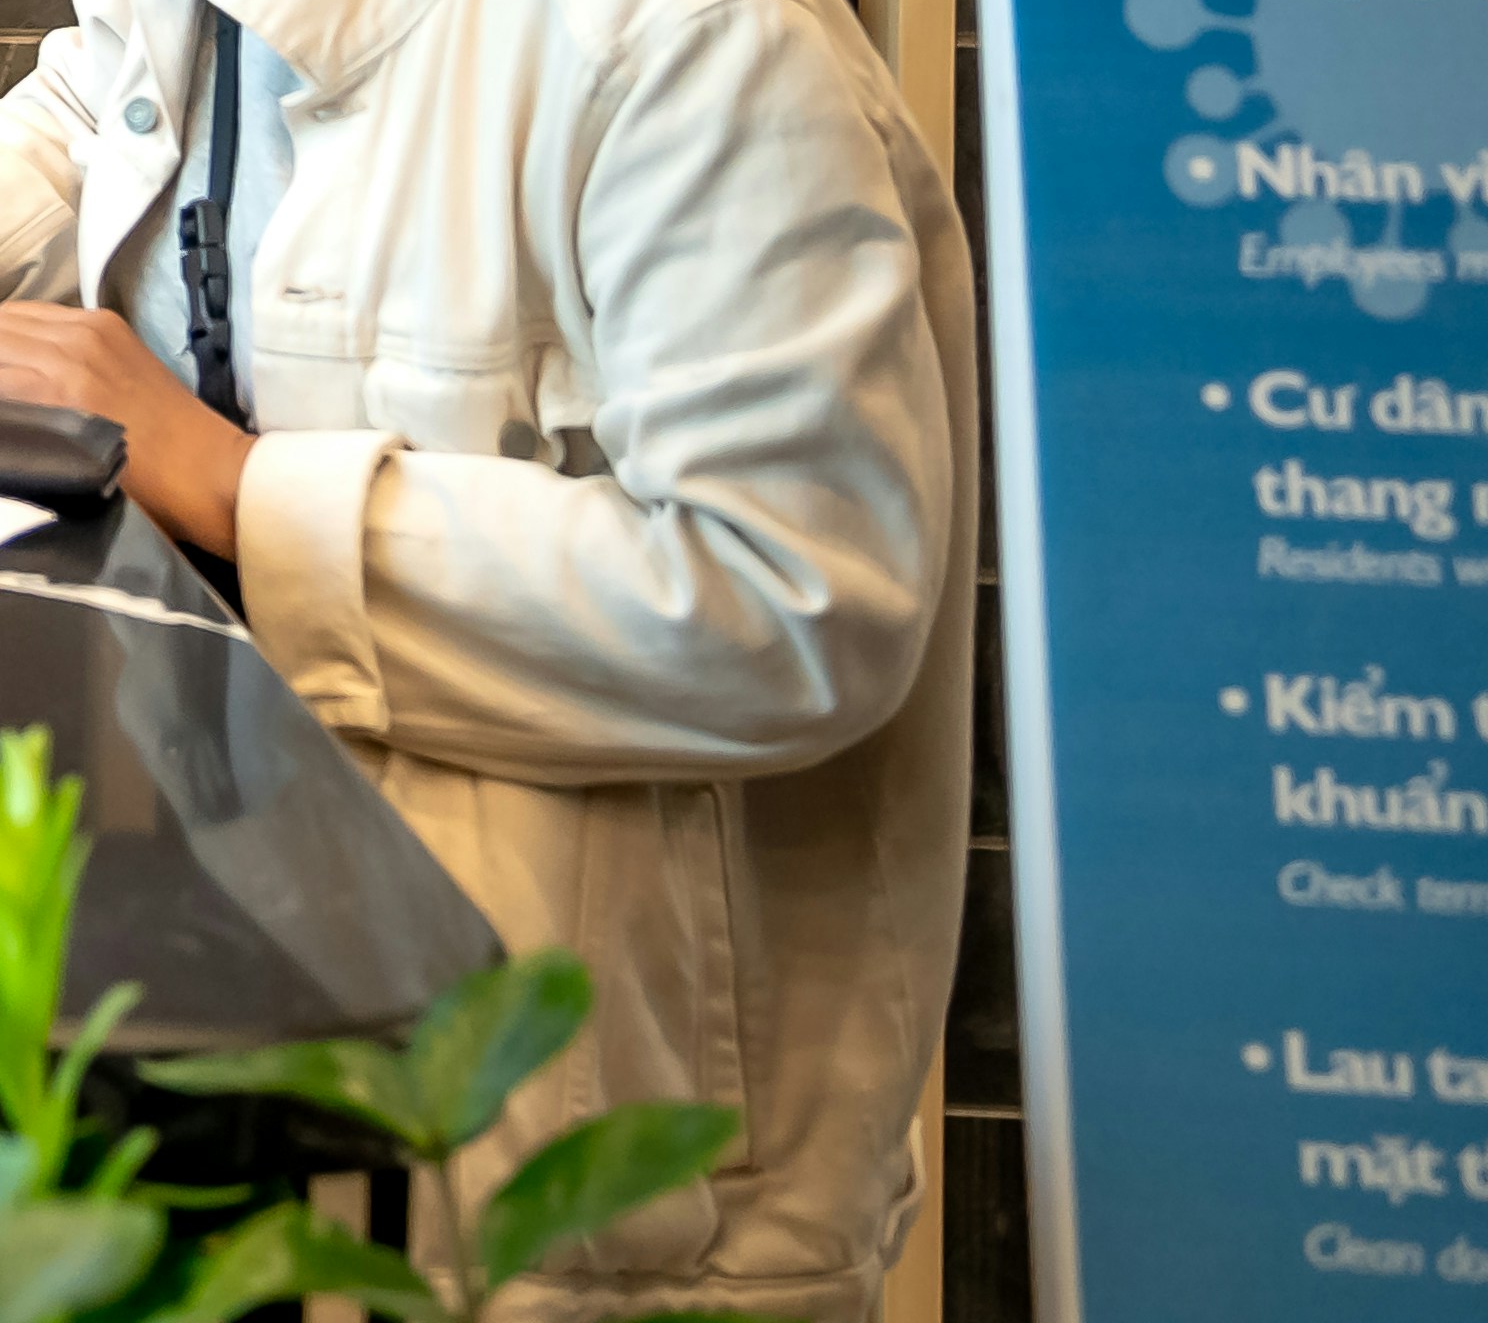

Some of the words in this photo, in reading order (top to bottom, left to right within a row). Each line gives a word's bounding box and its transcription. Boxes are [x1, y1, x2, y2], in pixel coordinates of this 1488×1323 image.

[1237, 143, 1424, 203] Nhân
[1253, 457, 1458, 542] thang
[1265, 662, 1457, 742] Kiểm
[1272, 758, 1488, 834] khuẩn
[1284, 1029, 1414, 1098] Lau
[1298, 1133, 1447, 1207] mặt
